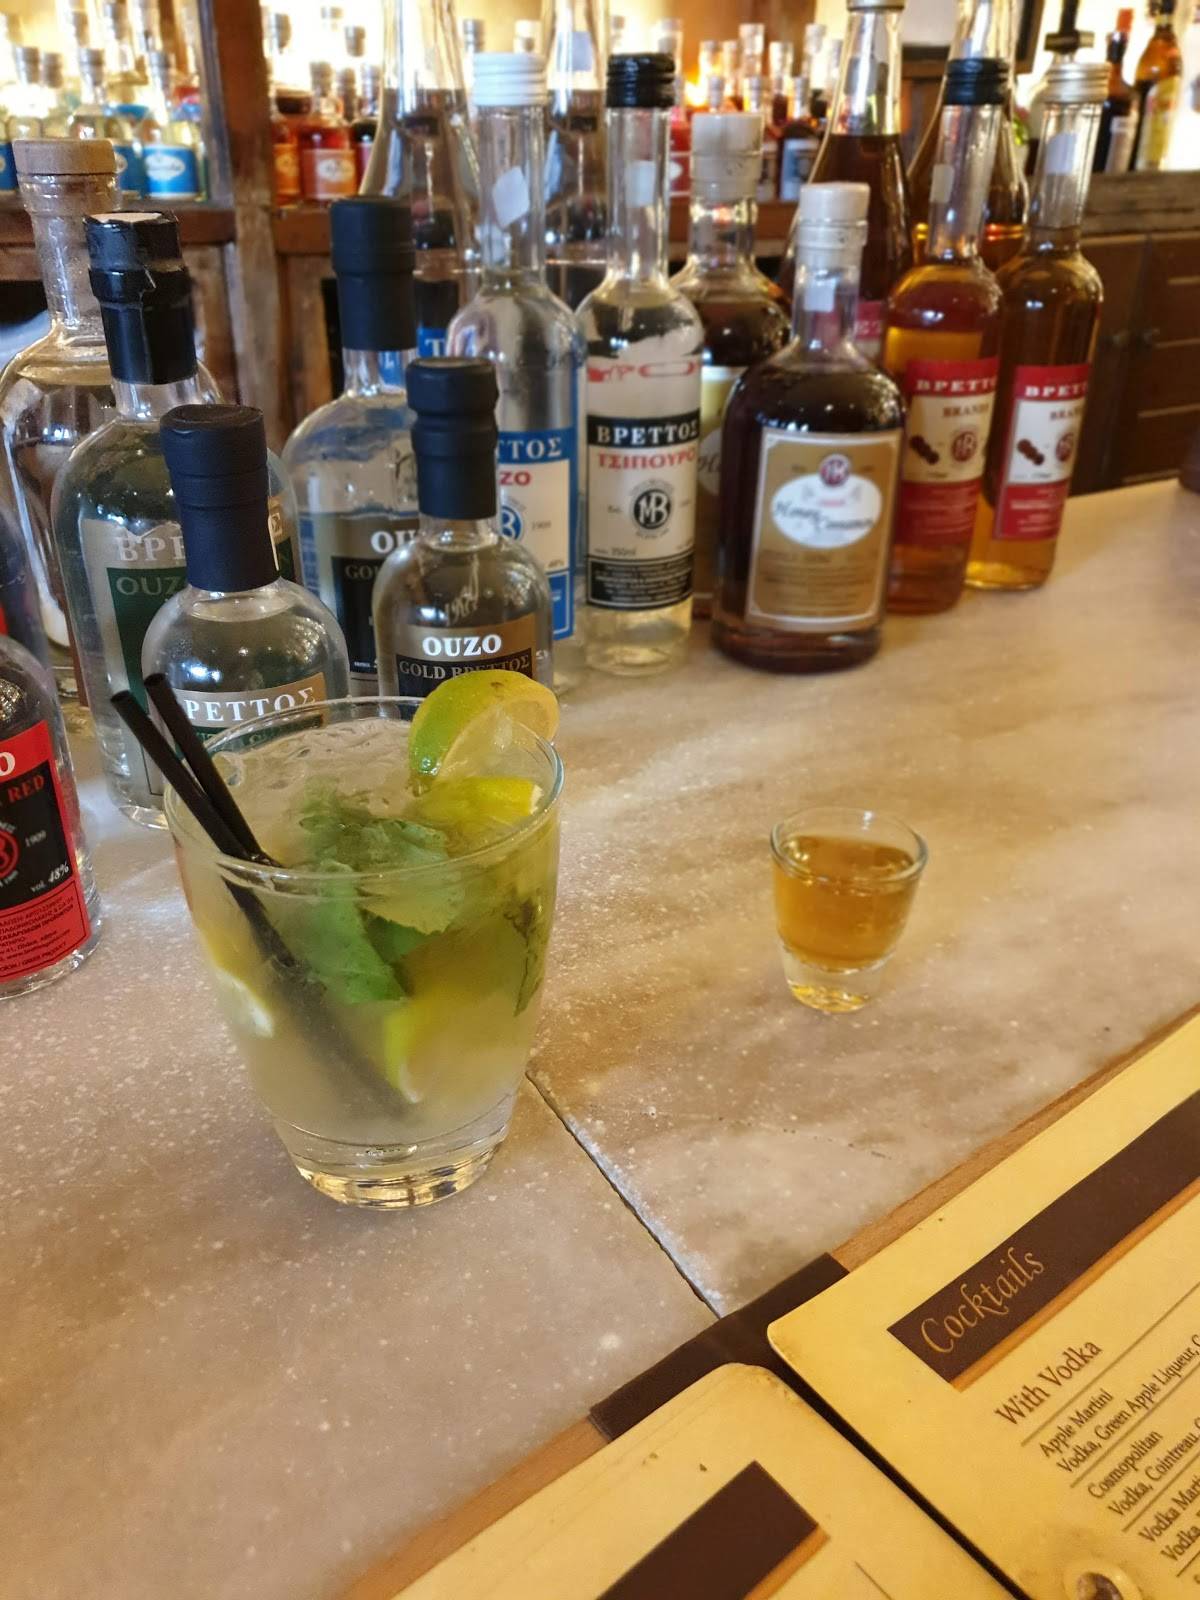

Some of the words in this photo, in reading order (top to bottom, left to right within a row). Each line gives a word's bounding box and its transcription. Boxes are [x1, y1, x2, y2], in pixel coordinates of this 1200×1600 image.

[597, 420, 698, 446] ΒΡΕΤΤΟΣ
[499, 471, 531, 485] ZO
[116, 576, 182, 596] OUZ
[422, 634, 501, 657] OUZO
[399, 659, 446, 680] GOLD
[184, 687, 316, 722] ΡΕΤΤΟΣ
[921, 1247, 1044, 1353] Cocktails
[994, 1385, 1051, 1425] With
[1037, 1341, 1103, 1387] Vodka
[1040, 1425, 1077, 1458] Apple
[1068, 1387, 1114, 1429] Martini
[1056, 1441, 1102, 1473] Vodka,
[1094, 1410, 1132, 1441] Green
[1125, 1383, 1162, 1413] Apple
[1152, 1346, 1200, 1386] Liqueur,
[1088, 1431, 1164, 1499] Cosmopolitan
[1108, 1482, 1155, 1517] Vodka,
[1138, 1508, 1182, 1544] Vodka
